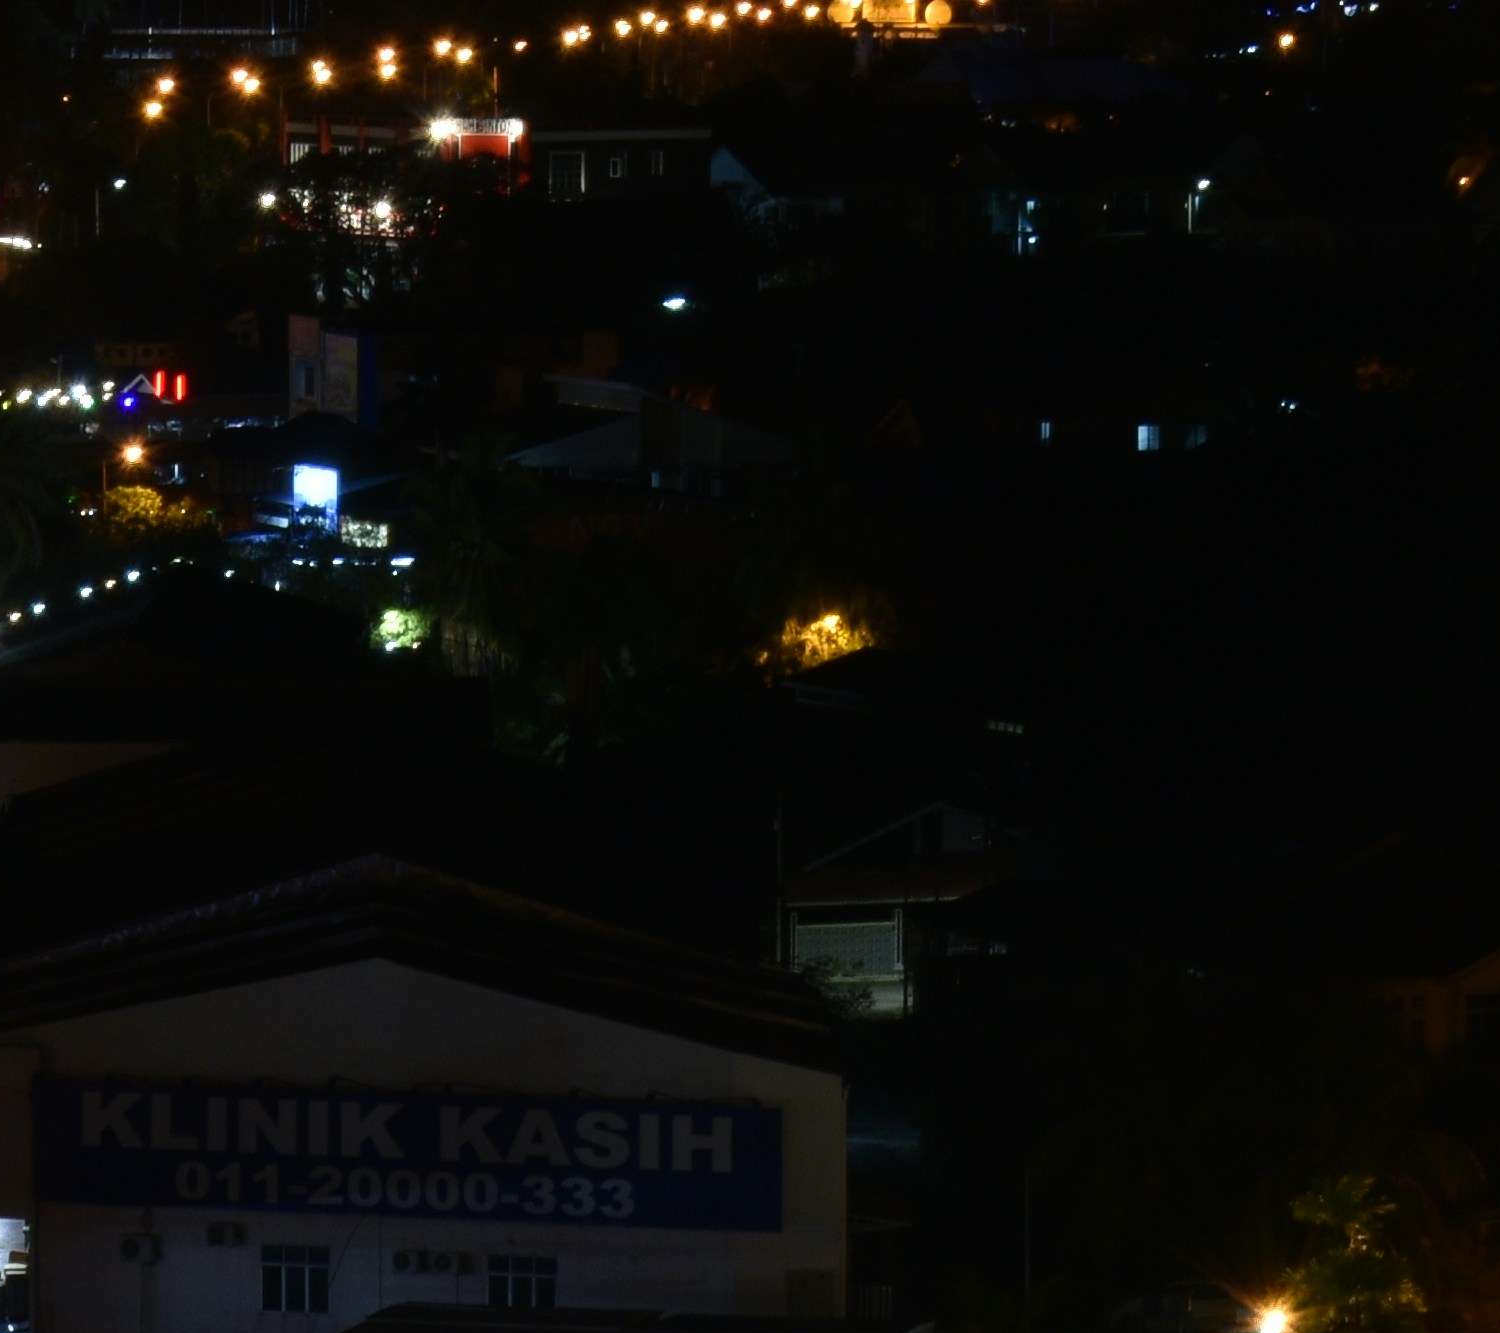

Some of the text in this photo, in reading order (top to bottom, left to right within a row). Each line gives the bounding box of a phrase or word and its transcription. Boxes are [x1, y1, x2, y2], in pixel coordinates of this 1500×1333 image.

[80, 1091, 734, 1175] KLINIK KASIH
[174, 1159, 637, 1219] 011-20000-333
